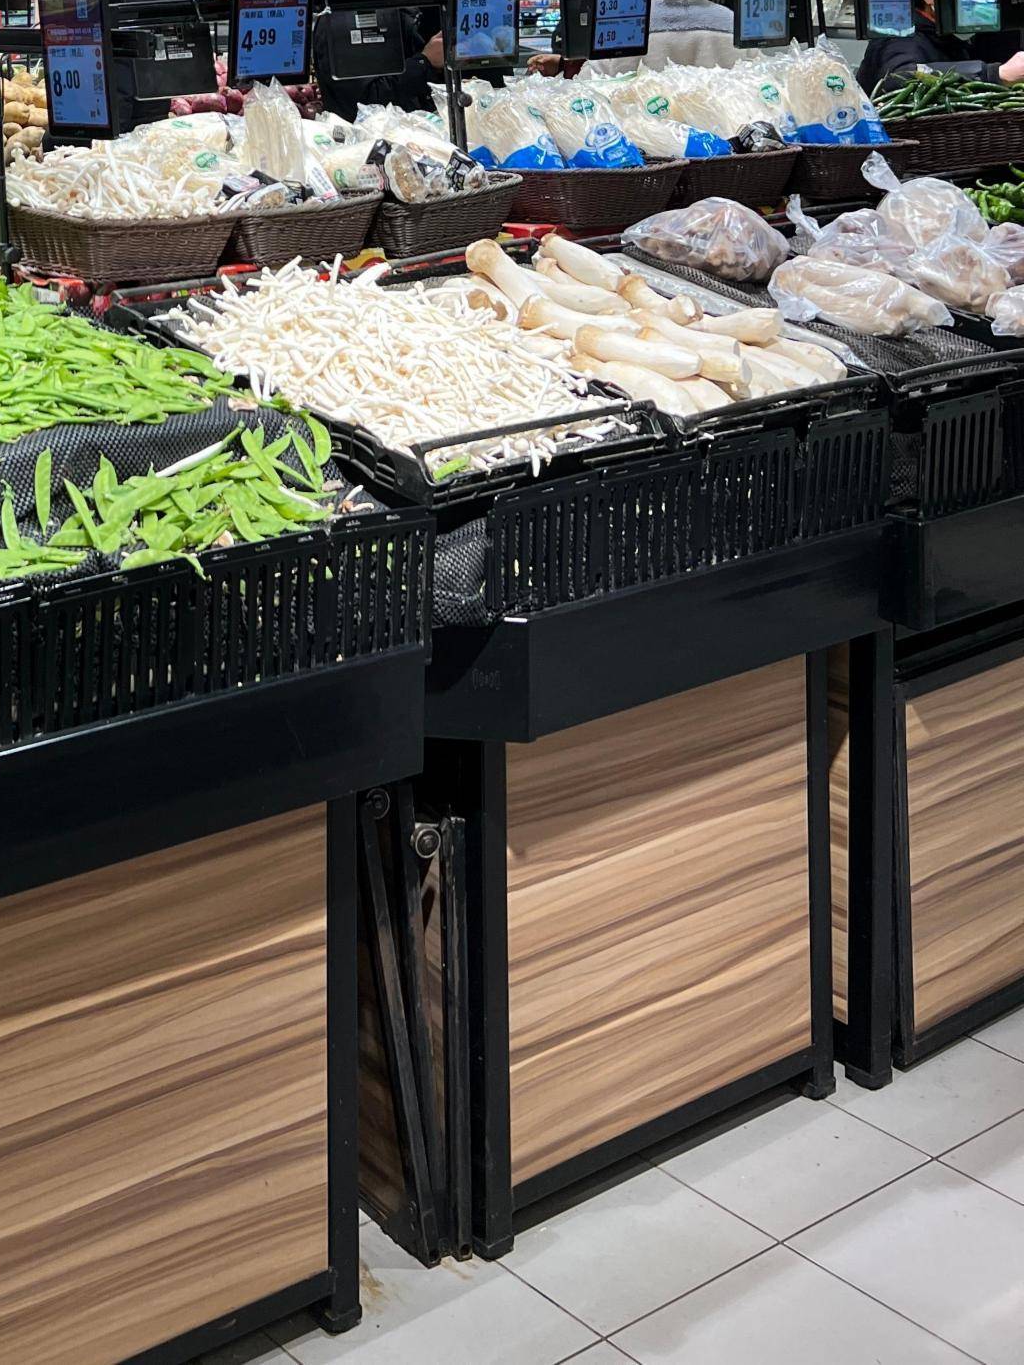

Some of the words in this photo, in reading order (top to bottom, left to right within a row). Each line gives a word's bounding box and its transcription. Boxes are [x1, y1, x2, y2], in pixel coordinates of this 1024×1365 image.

[599, 0, 618, 16] 3.30
[460, 13, 489, 35] 4.98
[241, 28, 276, 53] 4.99
[597, 30, 616, 47] 4.50
[53, 70, 80, 97] 8.00
